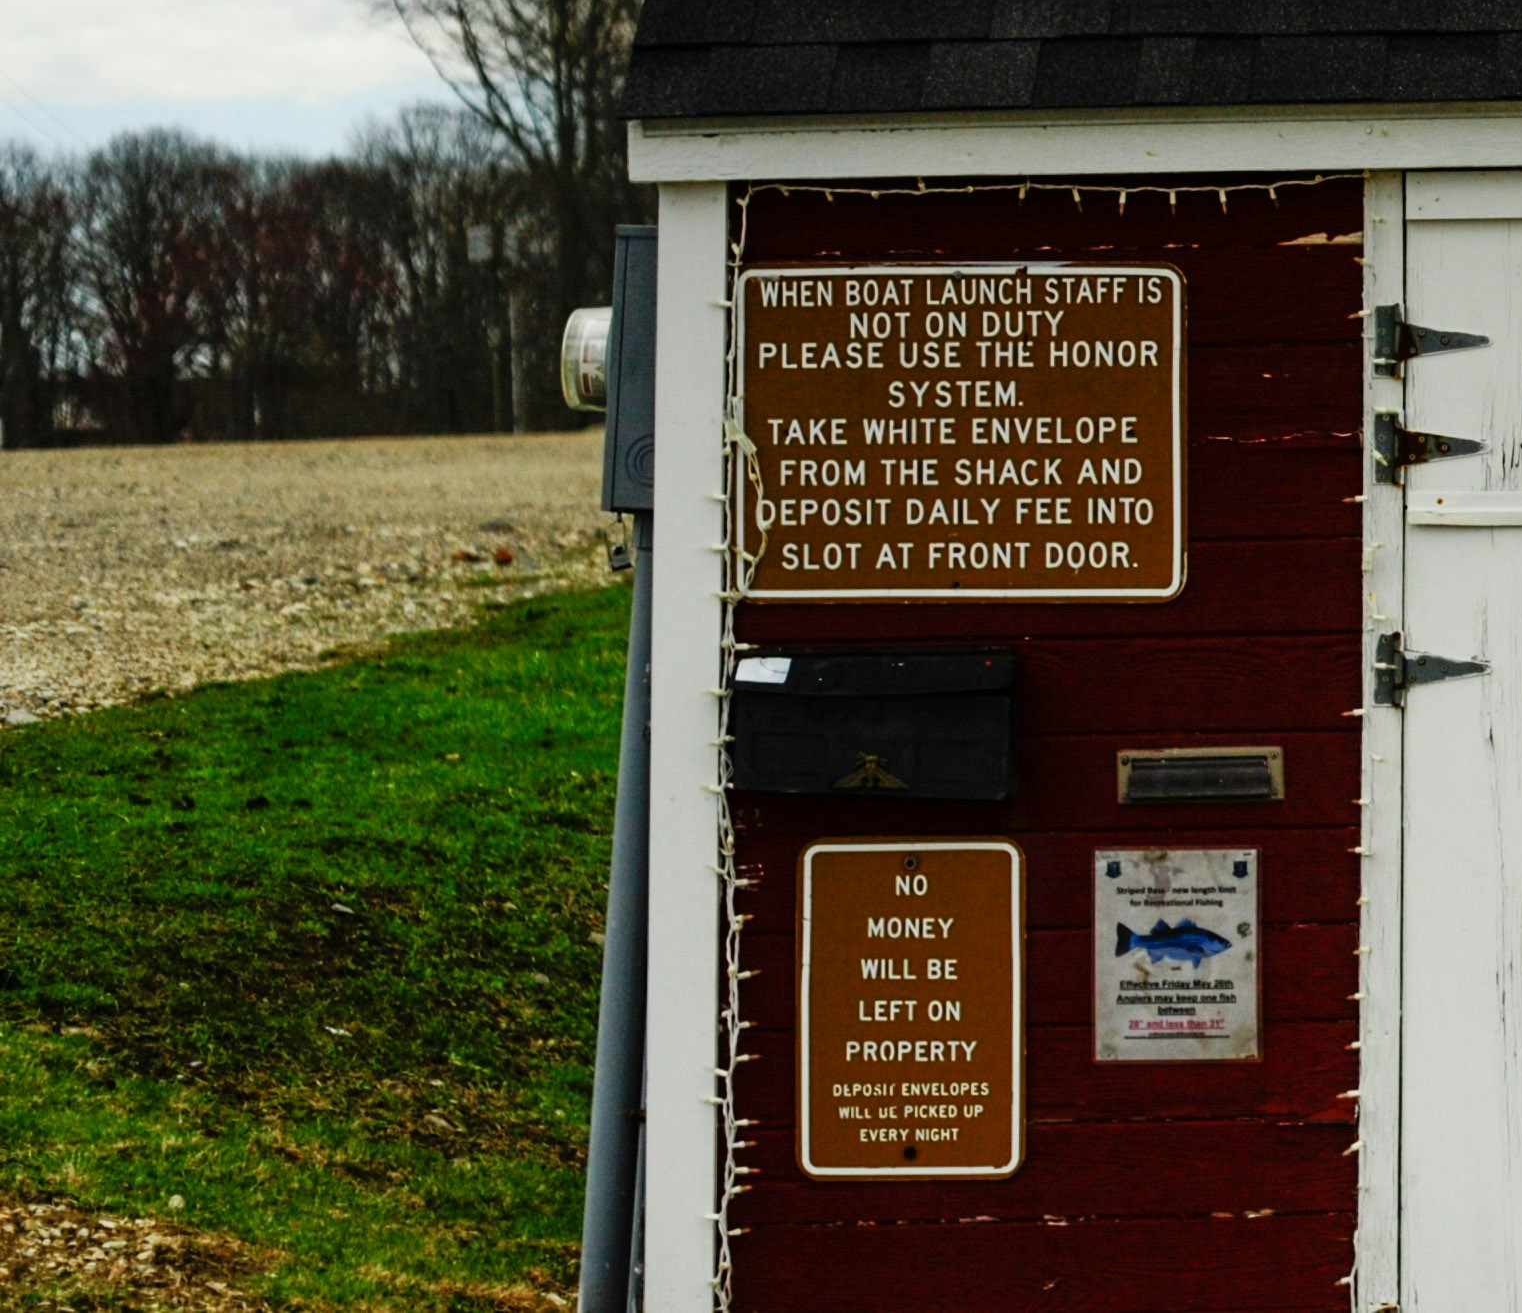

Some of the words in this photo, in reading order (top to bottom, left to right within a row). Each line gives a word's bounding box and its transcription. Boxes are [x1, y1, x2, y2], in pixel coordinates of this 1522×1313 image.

[760, 279, 833, 307] WHEN
[845, 279, 914, 306] BOAT
[926, 278, 1032, 305] LAUNCH
[1045, 277, 1127, 304] STAFF
[1138, 277, 1162, 304] IS
[850, 311, 911, 339] NOT
[925, 311, 967, 338] ON
[982, 310, 1064, 337] DUTY
[759, 342, 884, 369] PLEASE
[899, 341, 961, 369] USE
[975, 341, 1034, 368] THE
[1050, 340, 1158, 368] HONOR
[888, 380, 1023, 408] SYSTEM.
[767, 418, 847, 445] TAKE
[862, 418, 956, 445] WHITE
[972, 416, 1138, 444] ENVELOPE
[780, 459, 866, 487] FROM
[880, 459, 939, 486] THE
[954, 458, 1062, 486] SHACK
[1077, 458, 1142, 485] AND
[761, 498, 891, 527] DEPOSIT
[906, 498, 1000, 525] DAILY
[1016, 497, 1072, 525] FEE
[1087, 497, 1154, 525] INTO
[782, 542, 862, 570] SLOT
[875, 542, 914, 569] AT
[928, 542, 1031, 569] FRONT
[1045, 541, 1138, 569] DOOR.
[895, 874, 928, 896] NO
[867, 917, 954, 939] MONEY
[860, 958, 917, 980] WILL
[927, 958, 958, 980] BE
[859, 1000, 917, 1021] LEFT
[928, 1000, 961, 1022] ON
[846, 1040, 977, 1062] PROPERTY
[833, 1082, 896, 1097] DEPOSIT
[901, 1082, 989, 1097] ENVELOPES
[838, 1106, 872, 1119] WILL
[904, 1104, 958, 1119] PICKED
[963, 1104, 984, 1118] UP
[860, 1128, 909, 1142] EVERY
[915, 1128, 959, 1142] NIGHT
